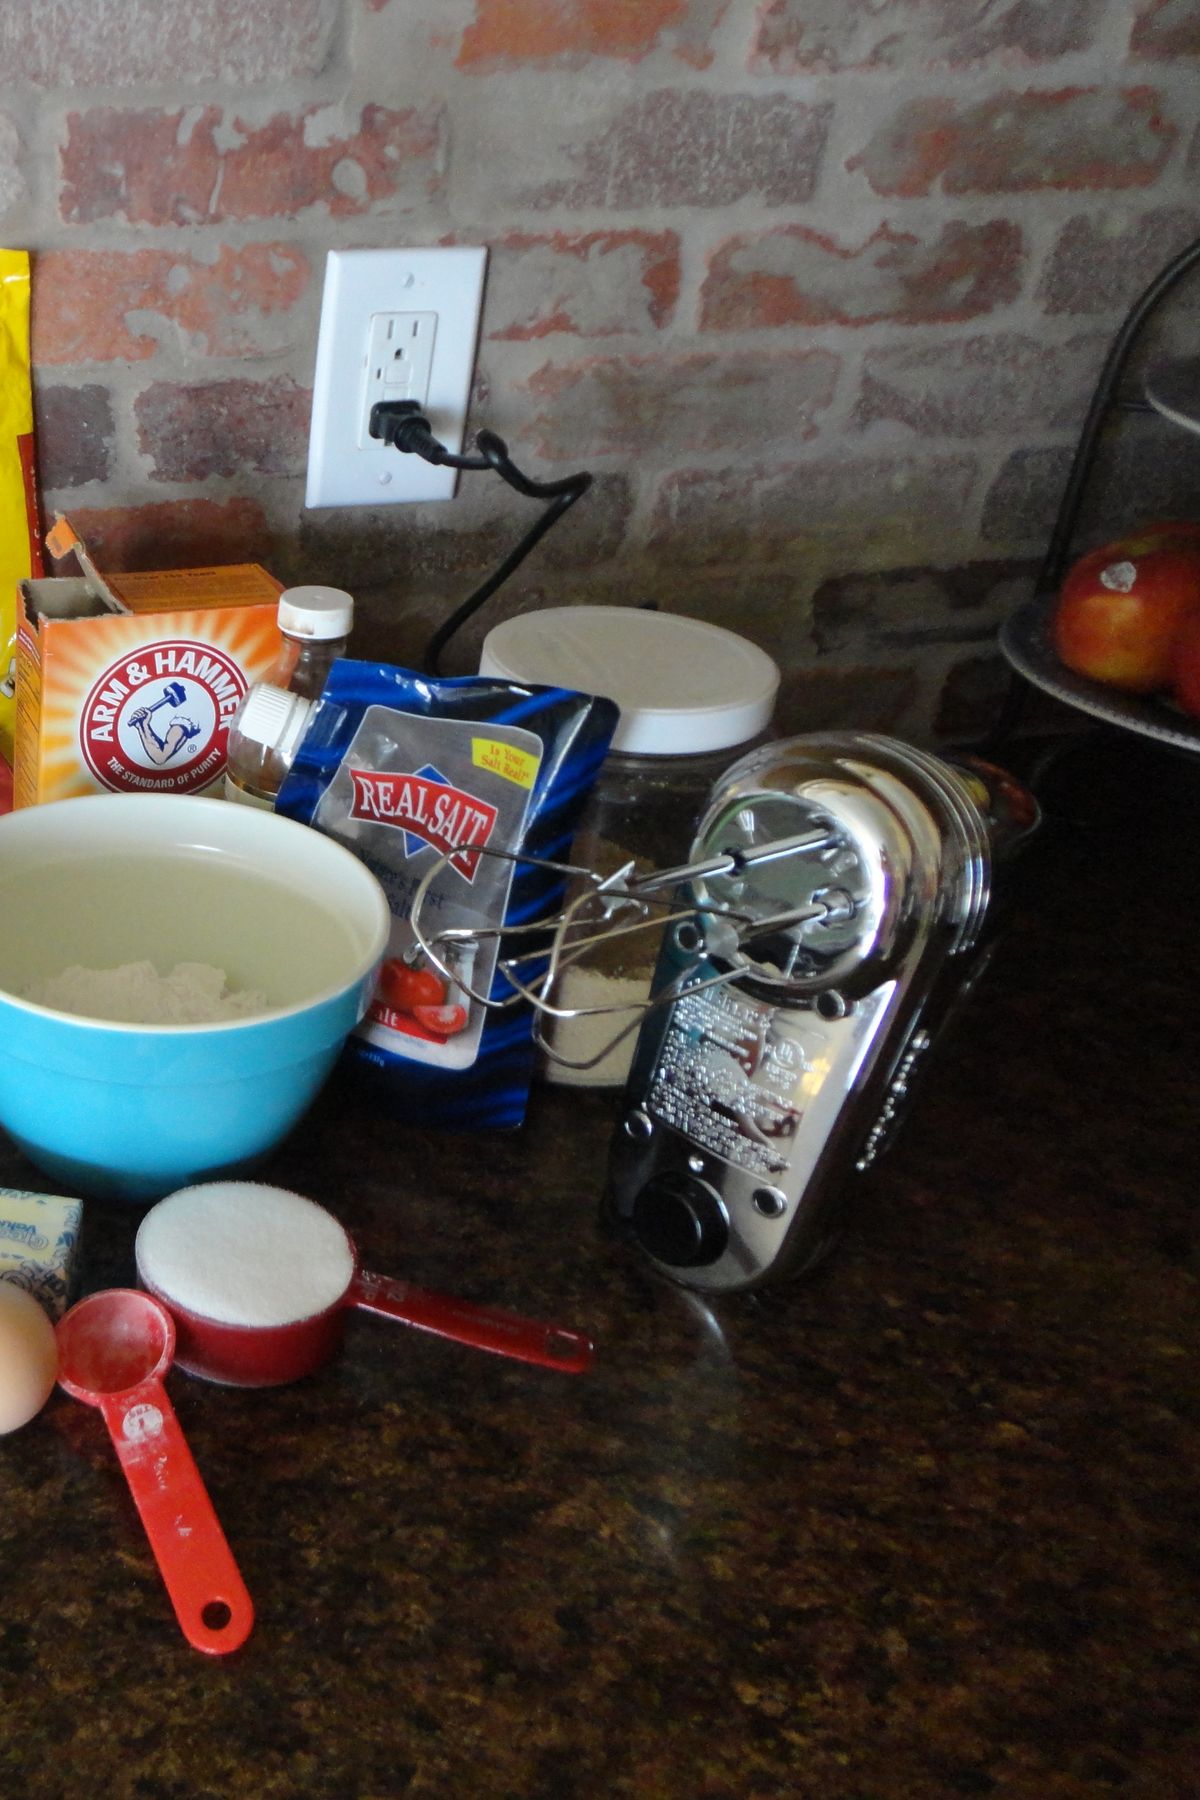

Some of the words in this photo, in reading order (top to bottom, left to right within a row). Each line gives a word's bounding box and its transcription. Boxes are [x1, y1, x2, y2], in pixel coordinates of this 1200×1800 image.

[90, 677, 131, 742] ARM
[126, 662, 152, 686] &
[154, 650, 242, 732] HAMMER
[106, 756, 125, 776] THE
[121, 771, 176, 789] STANDARD
[177, 773, 190, 785] OF
[191, 747, 222, 779] PURITY
[481, 754, 501, 770] Salt
[504, 747, 525, 767] Your
